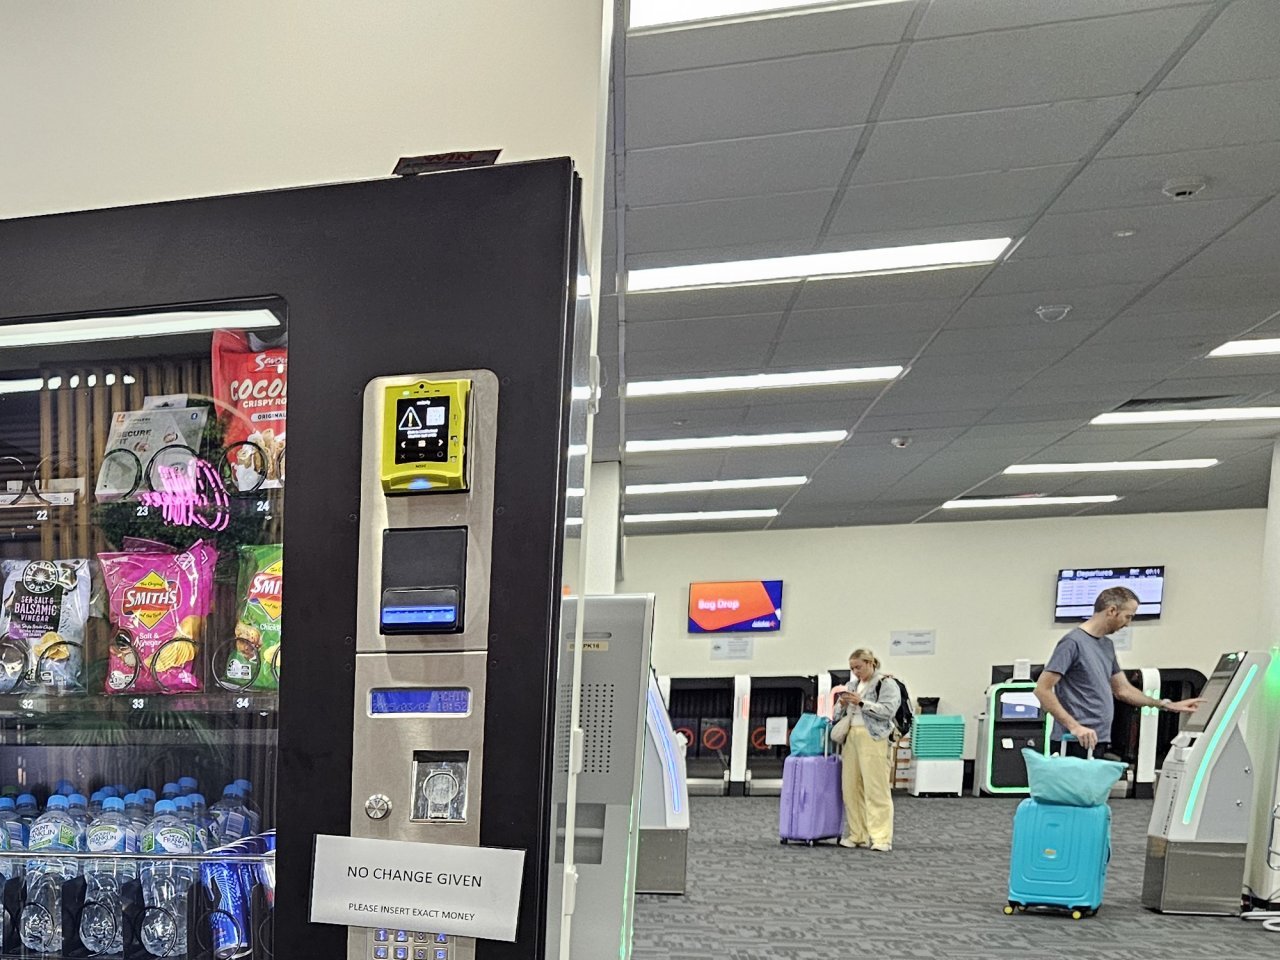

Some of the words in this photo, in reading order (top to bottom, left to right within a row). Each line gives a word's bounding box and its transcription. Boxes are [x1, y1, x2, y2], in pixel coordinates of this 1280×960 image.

[242, 400, 274, 409] CRISPY
[136, 506, 149, 516] 23
[256, 501, 269, 511] 24
[36, 510, 48, 521] 22
[29, 584, 51, 592] DELI
[14, 601, 57, 616] BALSAMIC
[698, 599, 716, 611] Bag
[717, 599, 740, 610] Drop
[20, 613, 50, 622] VINEGAR
[139, 632, 151, 640] Salt
[22, 699, 34, 709] 32
[132, 698, 144, 708] 33
[236, 698, 250, 708] 34
[347, 865, 369, 879] NO
[373, 868, 433, 884] CHANGE
[437, 872, 483, 888] GIVEN
[348, 902, 379, 914] PLEASE
[380, 905, 410, 916] INSERT
[412, 909, 440, 919] EXACT
[441, 911, 475, 921] MONEY
